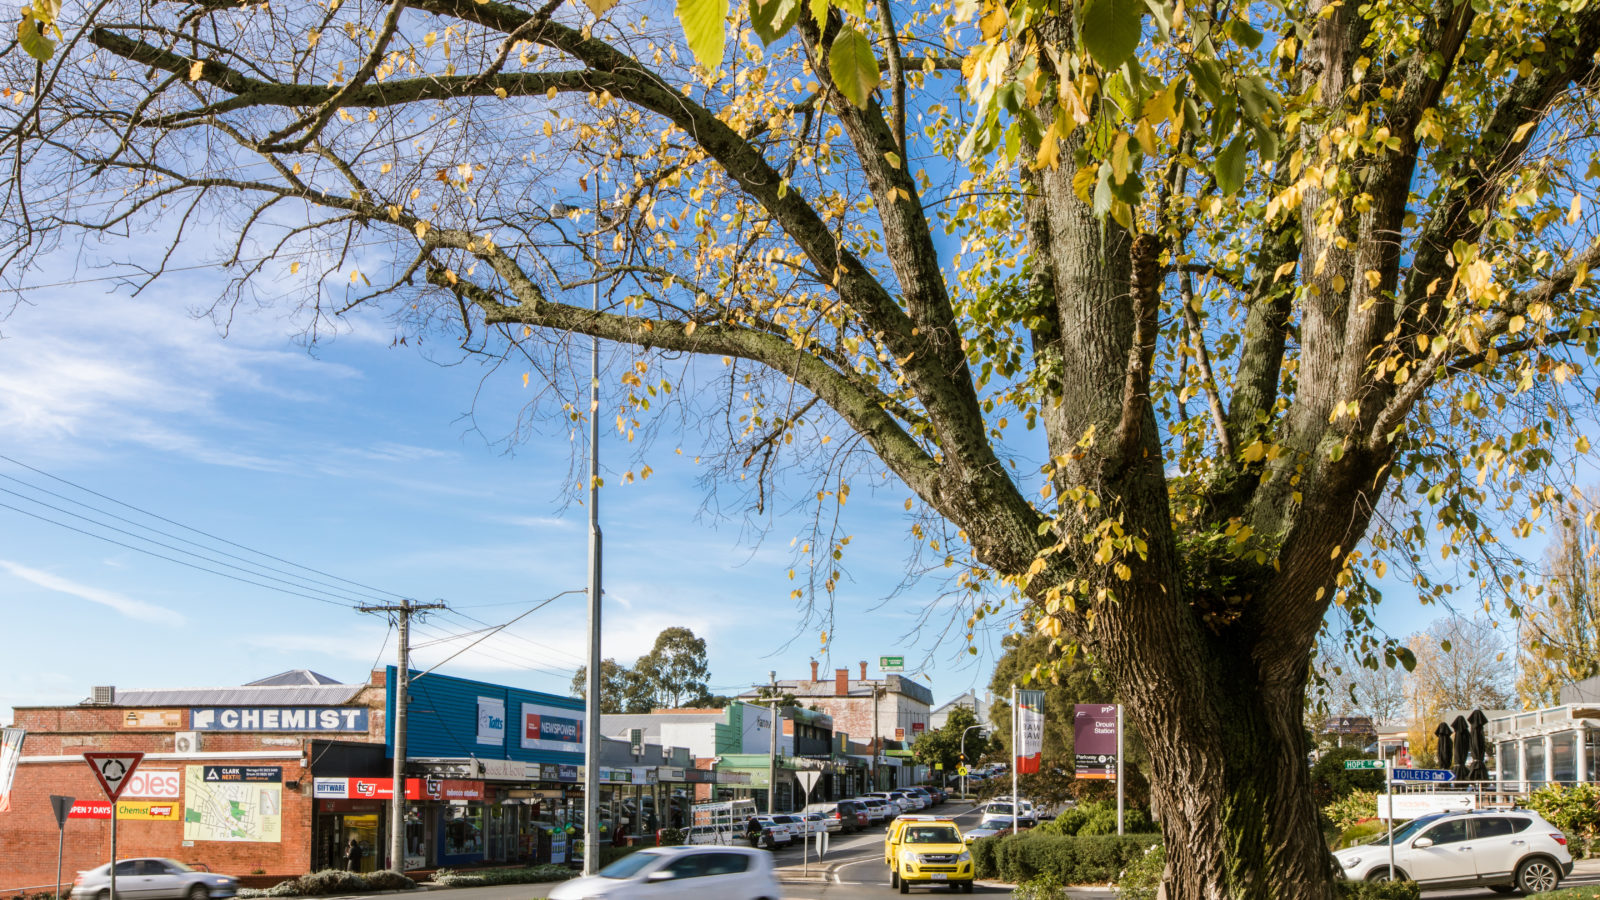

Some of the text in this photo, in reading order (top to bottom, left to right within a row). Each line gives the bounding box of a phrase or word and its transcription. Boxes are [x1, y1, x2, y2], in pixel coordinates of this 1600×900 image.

[220, 709, 361, 729] CHEMIST
[541, 721, 576, 737] NEWSPOWER
[1346, 760, 1365, 769] HOPE
[1396, 770, 1430, 780] TOILETS
[317, 783, 345, 792] GIFTWARE
[357, 780, 378, 797] tsg
[426, 774, 444, 800] tsg
[87, 806, 92, 814] 7
[93, 806, 111, 814] DAYS
[119, 805, 149, 815] Chemist
